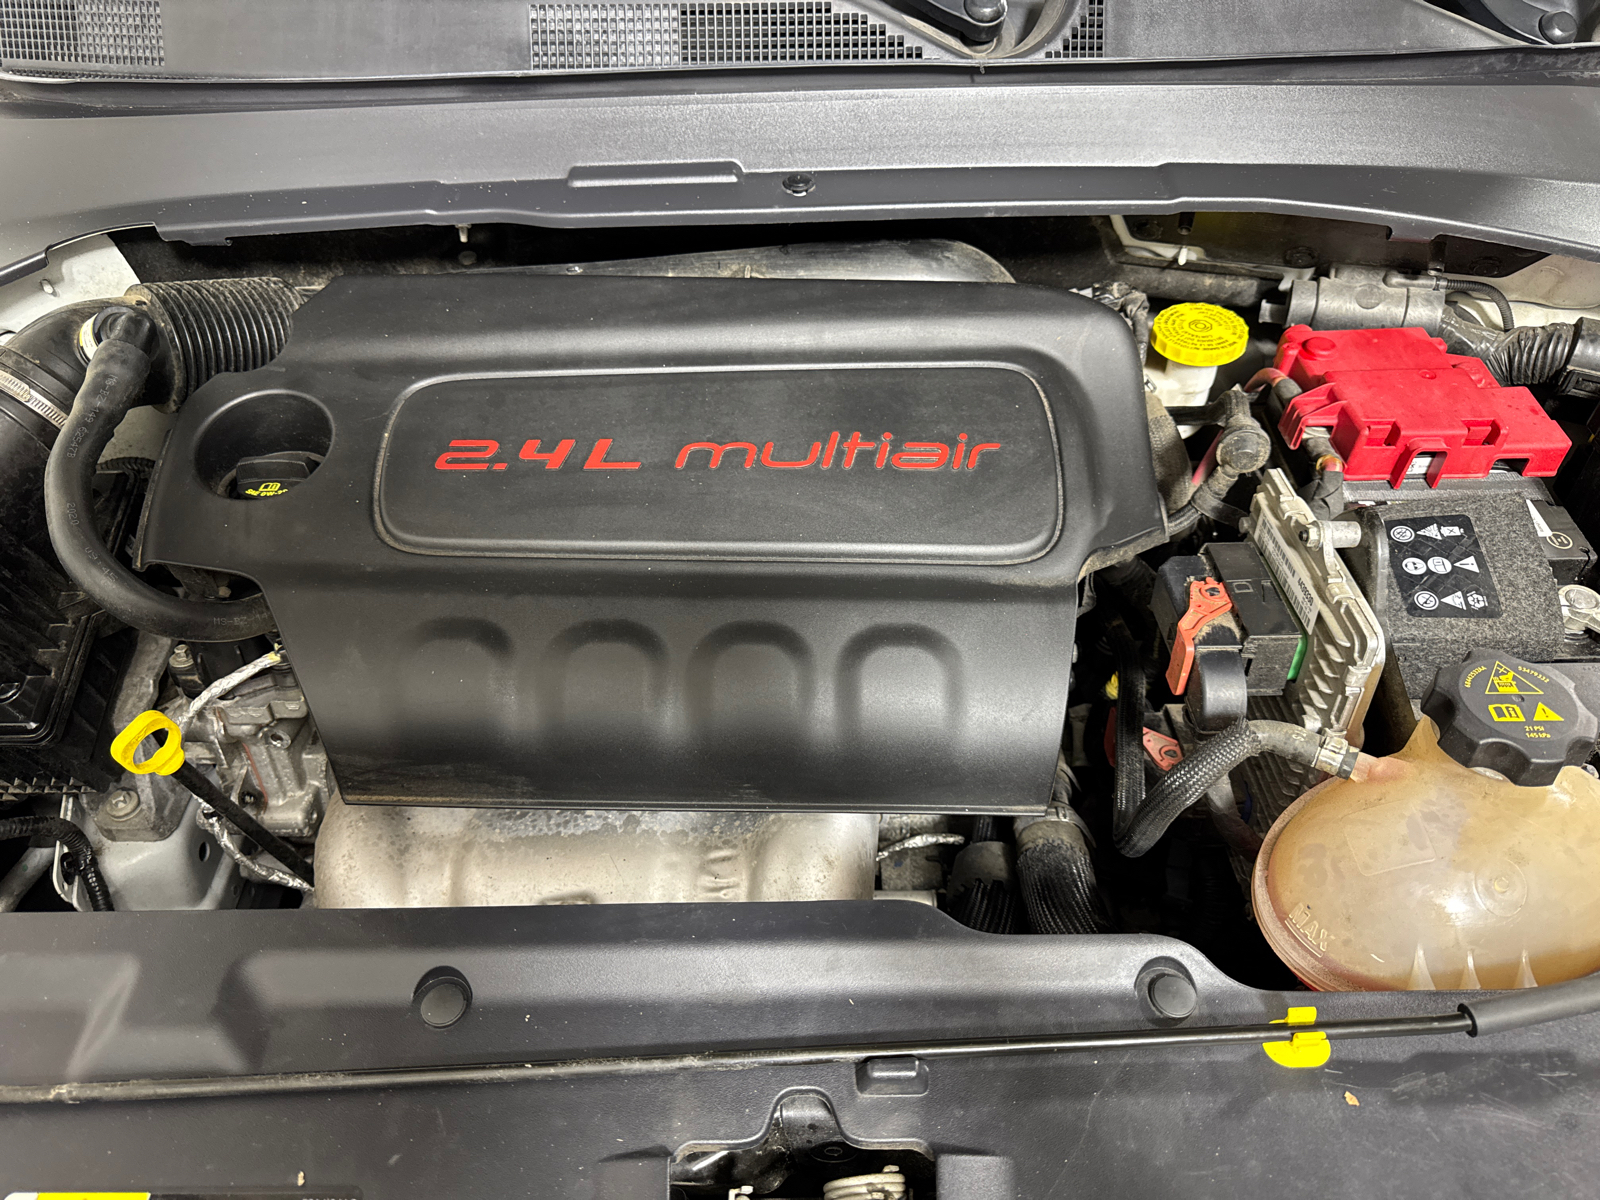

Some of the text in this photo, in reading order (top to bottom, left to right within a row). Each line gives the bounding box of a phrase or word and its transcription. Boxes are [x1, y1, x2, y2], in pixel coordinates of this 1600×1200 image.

[435, 431, 1001, 470] 2.4L multiair
[1288, 902, 1336, 952] MAX
